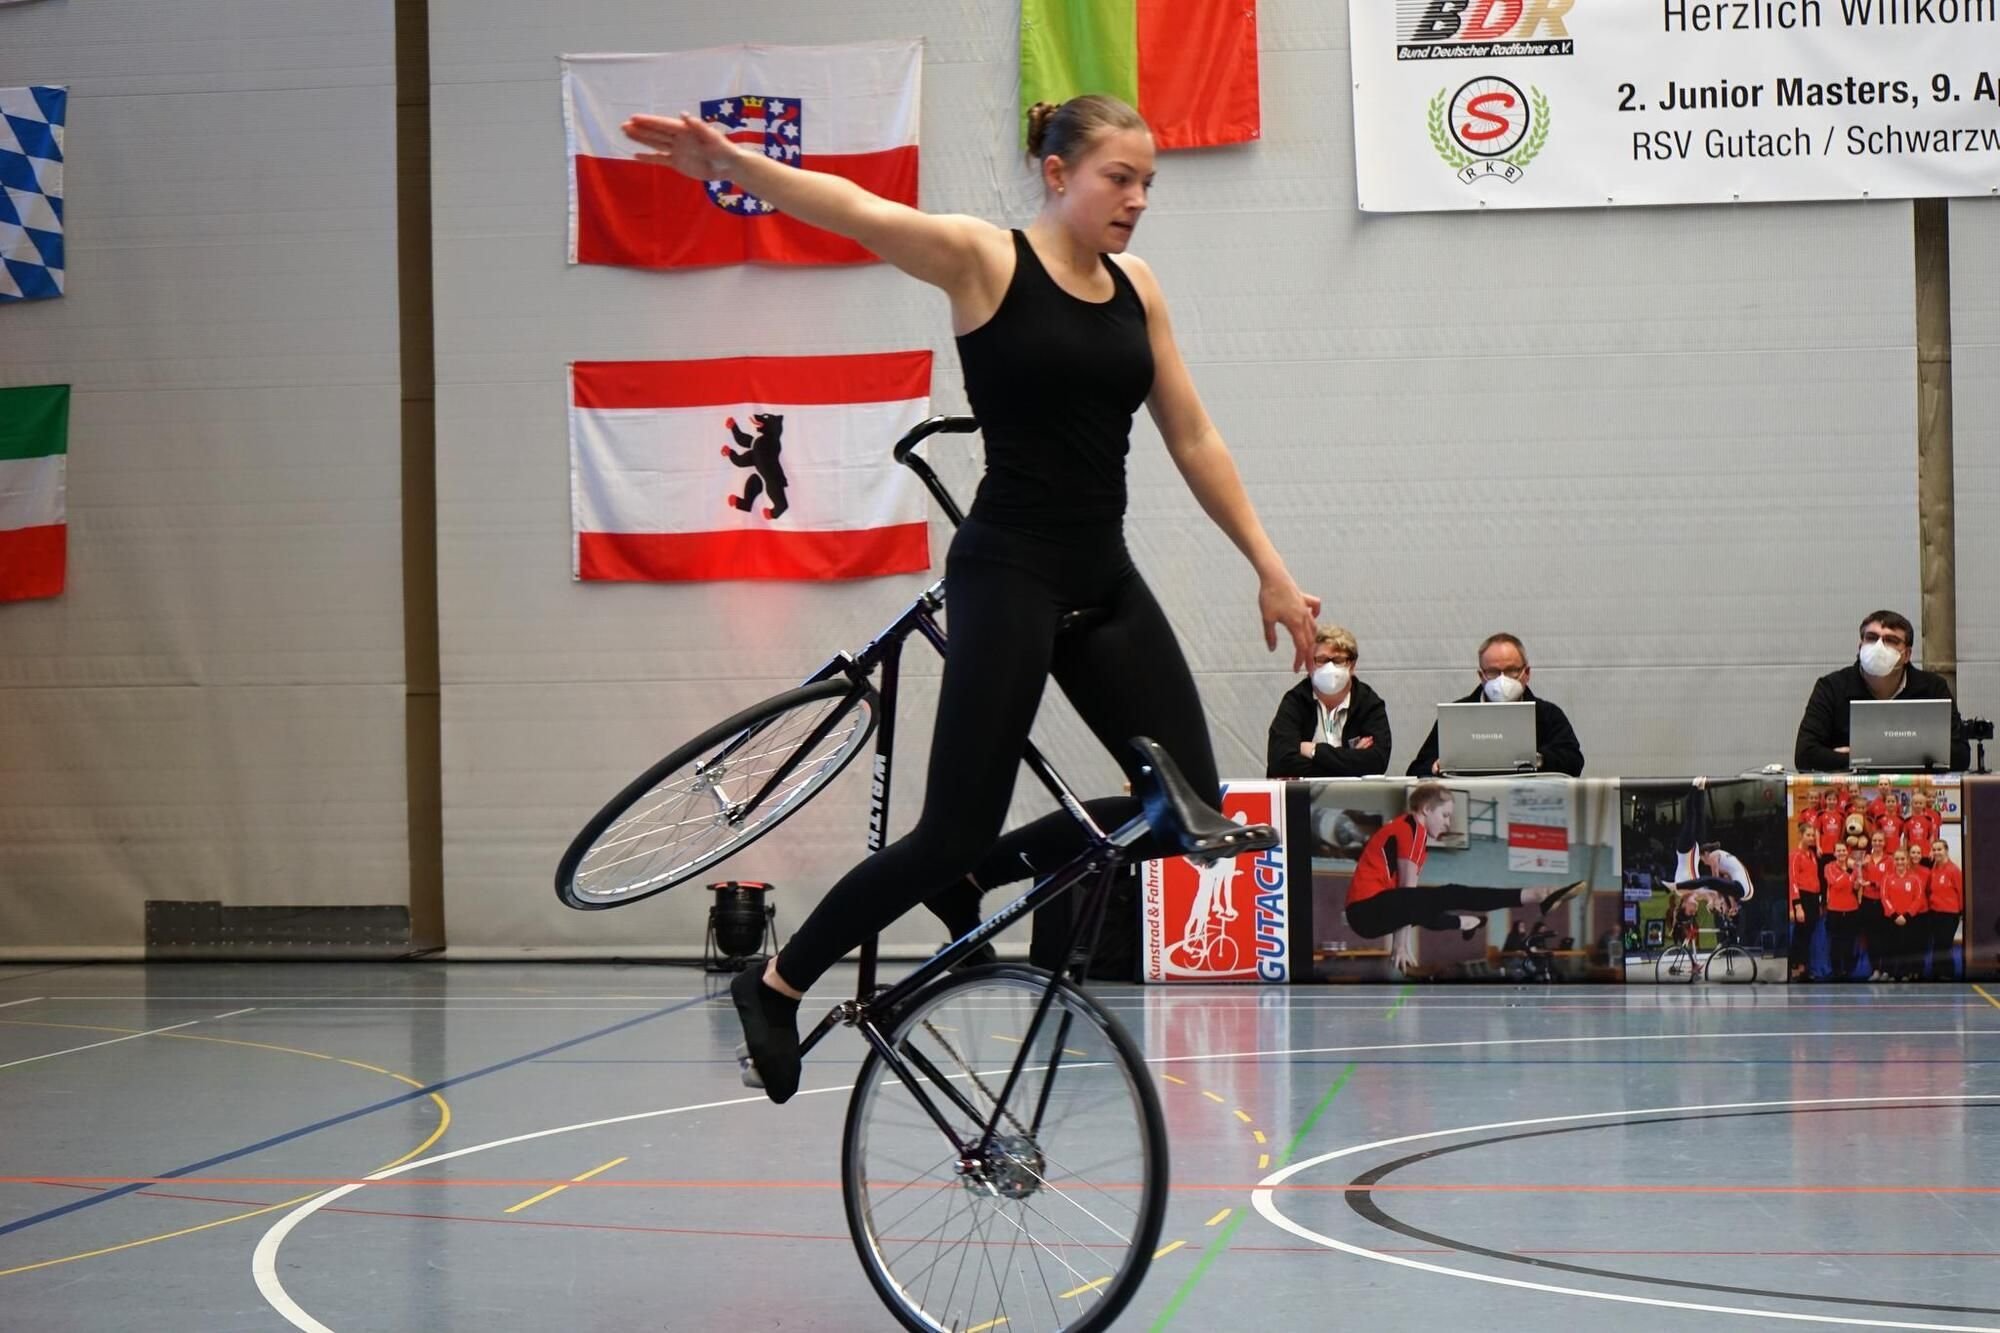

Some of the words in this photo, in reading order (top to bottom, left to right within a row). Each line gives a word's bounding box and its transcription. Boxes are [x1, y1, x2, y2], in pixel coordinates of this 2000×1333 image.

[1409, 0, 1575, 41] BDR
[1664, 0, 1821, 32] Herzlich
[1399, 46, 1431, 59] Bund
[1431, 45, 1489, 58] Deutscher
[1490, 43, 1548, 56] Radfahrer
[1618, 83, 1646, 112] 2.
[1659, 79, 1764, 111] Junior
[1776, 76, 1919, 109] Masters,
[1931, 73, 1960, 102] 9.
[1973, 72, 2000, 107] A
[1633, 130, 1692, 161] RSV
[1705, 127, 1811, 158] Gutach
[1824, 126, 1834, 156] /
[1847, 124, 2000, 155] Schwarzw
[1148, 907, 1160, 918] &
[1256, 846, 1285, 982] GUTACH
[1148, 919, 1161, 981] Kunstrad
